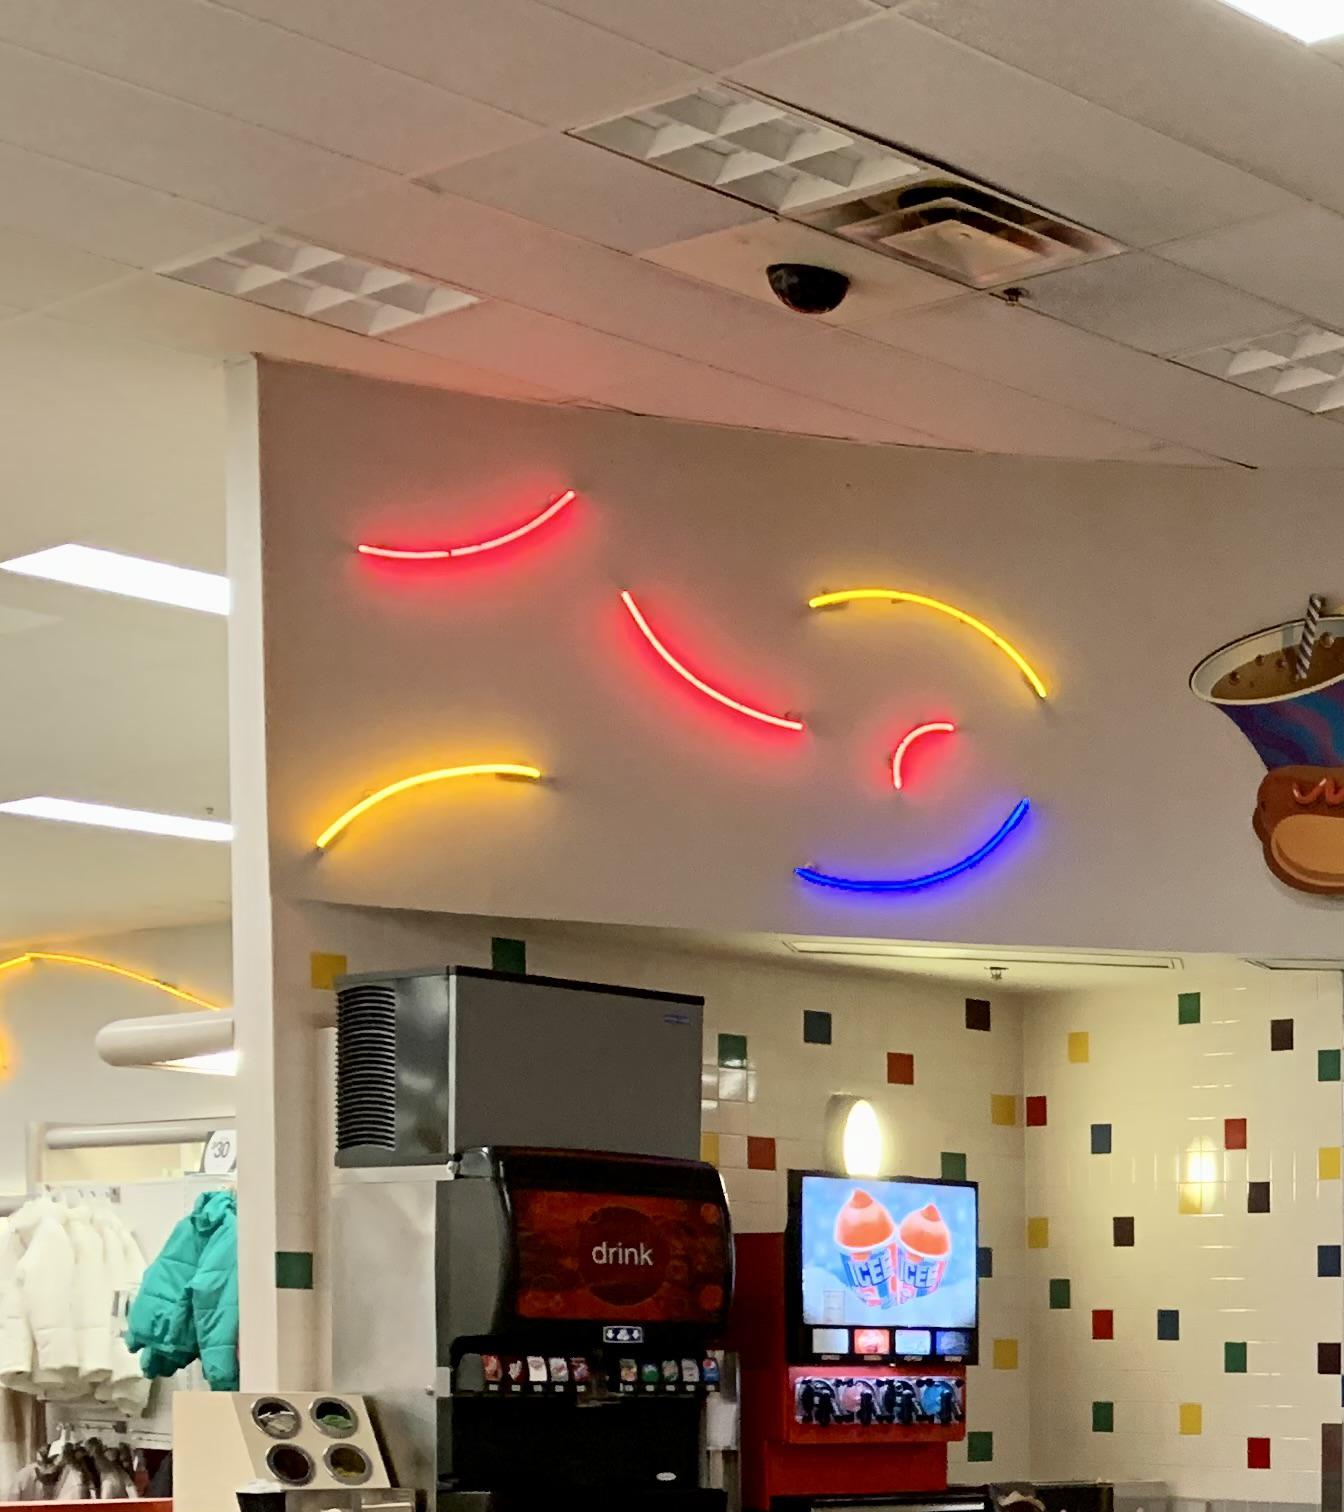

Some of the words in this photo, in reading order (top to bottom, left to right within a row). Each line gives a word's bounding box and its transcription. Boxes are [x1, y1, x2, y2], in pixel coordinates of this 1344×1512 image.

[591, 1241, 653, 1267] drink
[848, 1256, 894, 1288] ICEE
[903, 1261, 939, 1288] ICEE
